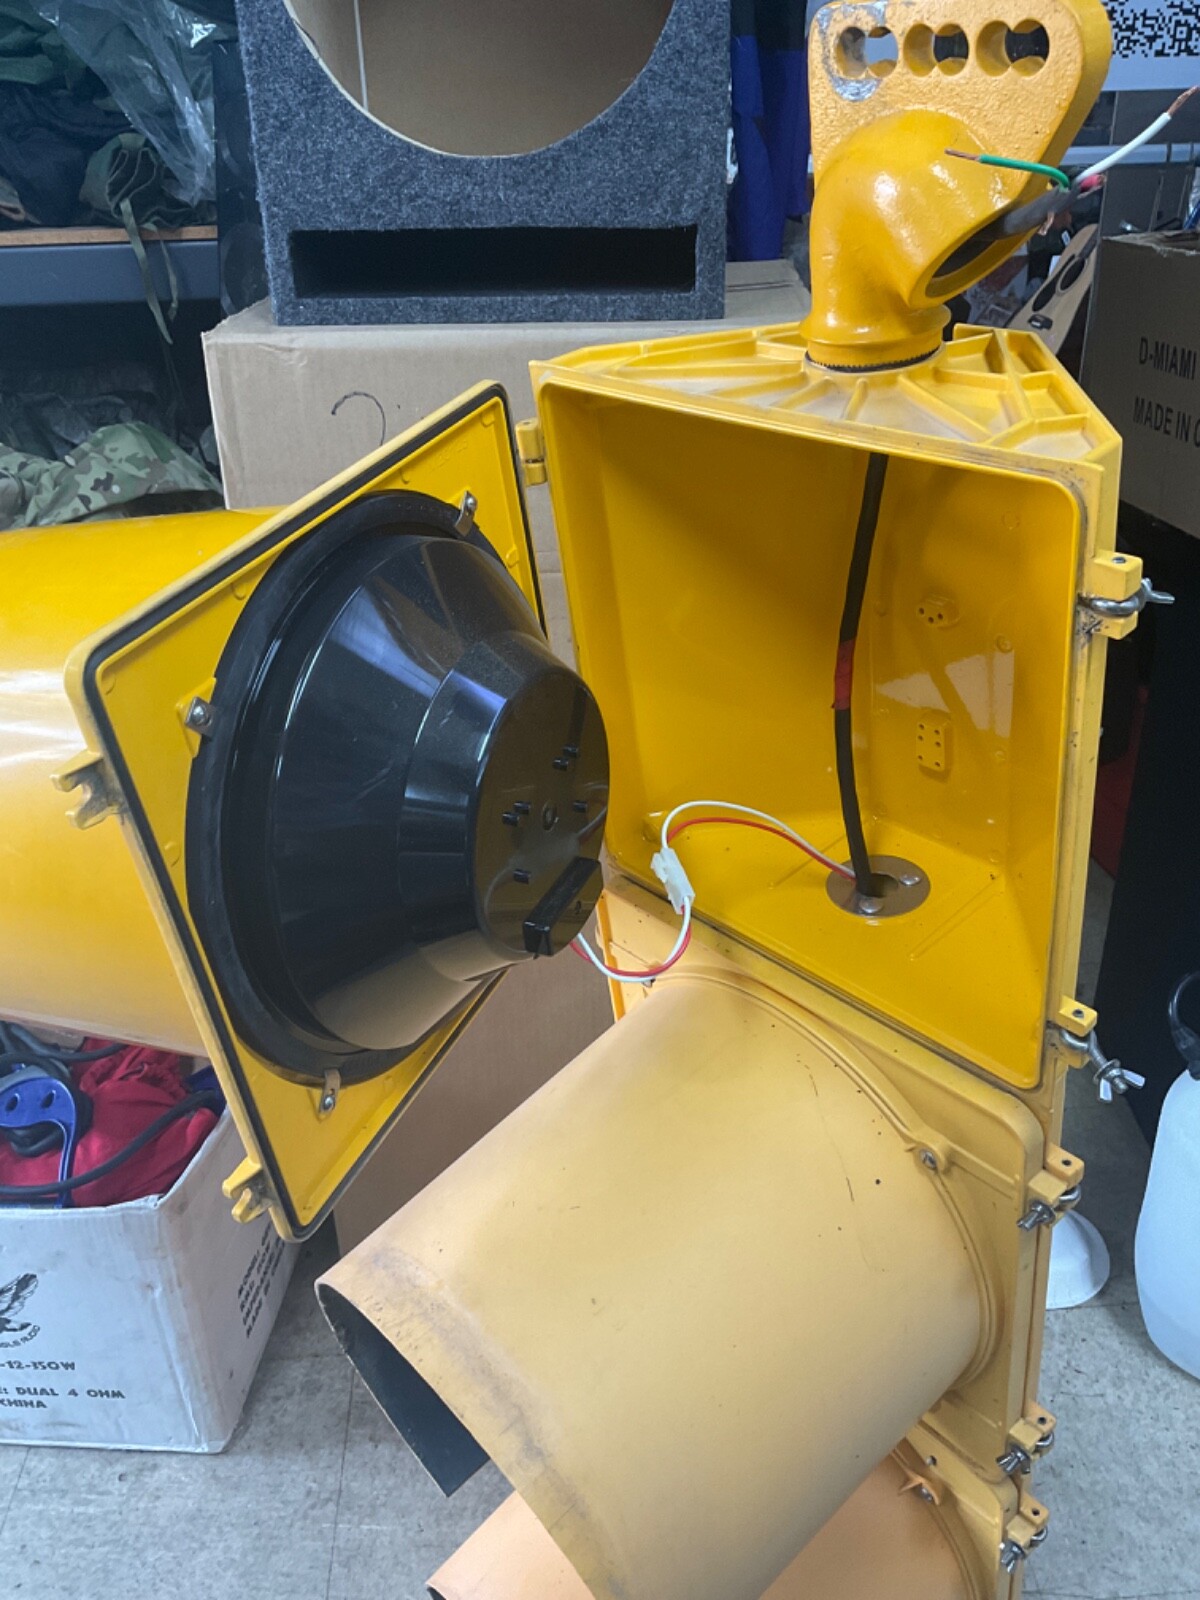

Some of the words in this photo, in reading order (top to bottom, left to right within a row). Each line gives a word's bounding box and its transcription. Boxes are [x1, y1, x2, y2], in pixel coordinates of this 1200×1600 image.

[1139, 336, 1197, 380] D-MIAMI
[1133, 396, 1174, 436] MADE
[1175, 411, 1191, 442] IN
[15, 1386, 60, 1396] DUAL
[67, 1388, 79, 1397] 4
[86, 1388, 126, 1399] OHM
